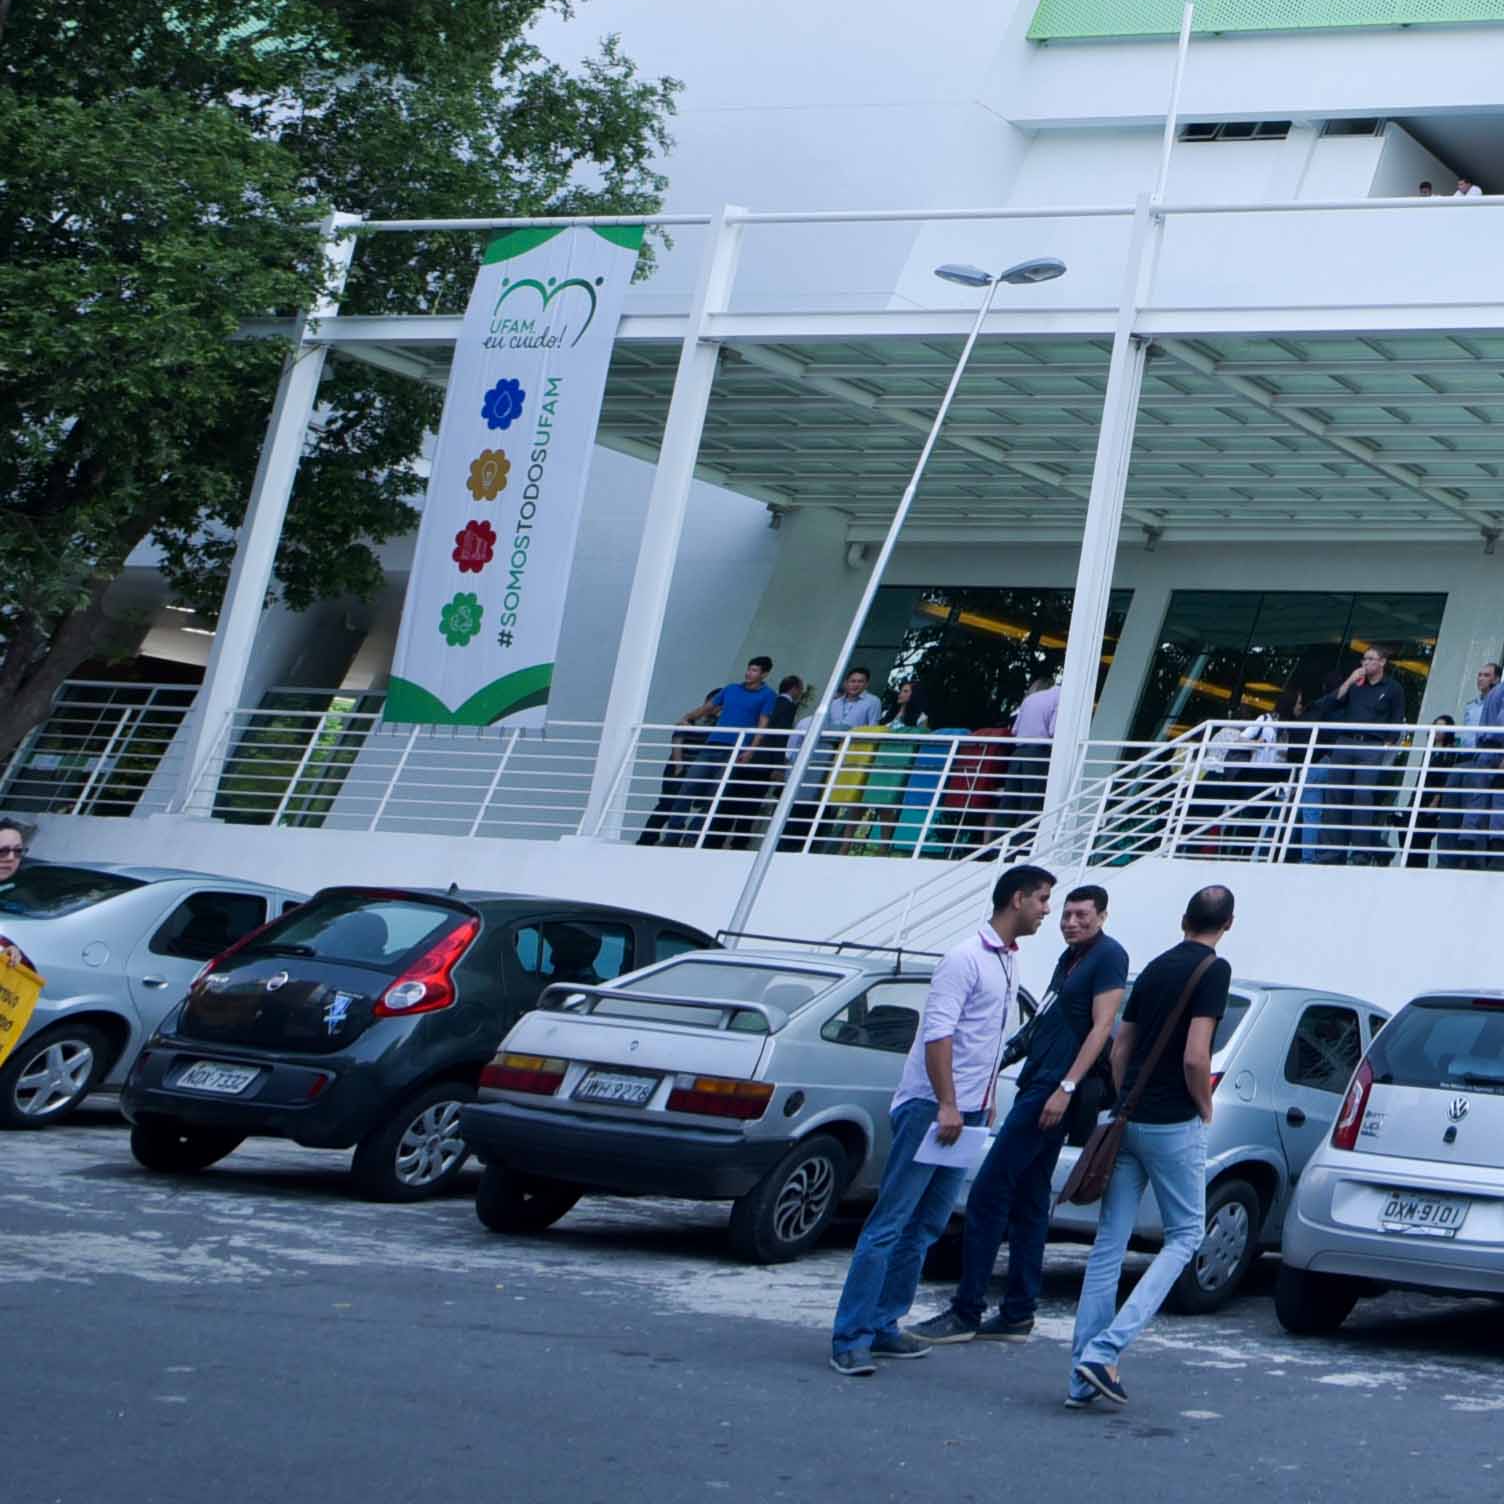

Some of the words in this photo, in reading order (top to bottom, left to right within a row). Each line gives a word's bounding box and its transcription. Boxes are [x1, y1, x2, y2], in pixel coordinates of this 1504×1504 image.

[482, 336, 506, 349] eu
[510, 323, 567, 349] cuido!
[497, 377, 563, 648] #SOMOSTODOSUFAM
